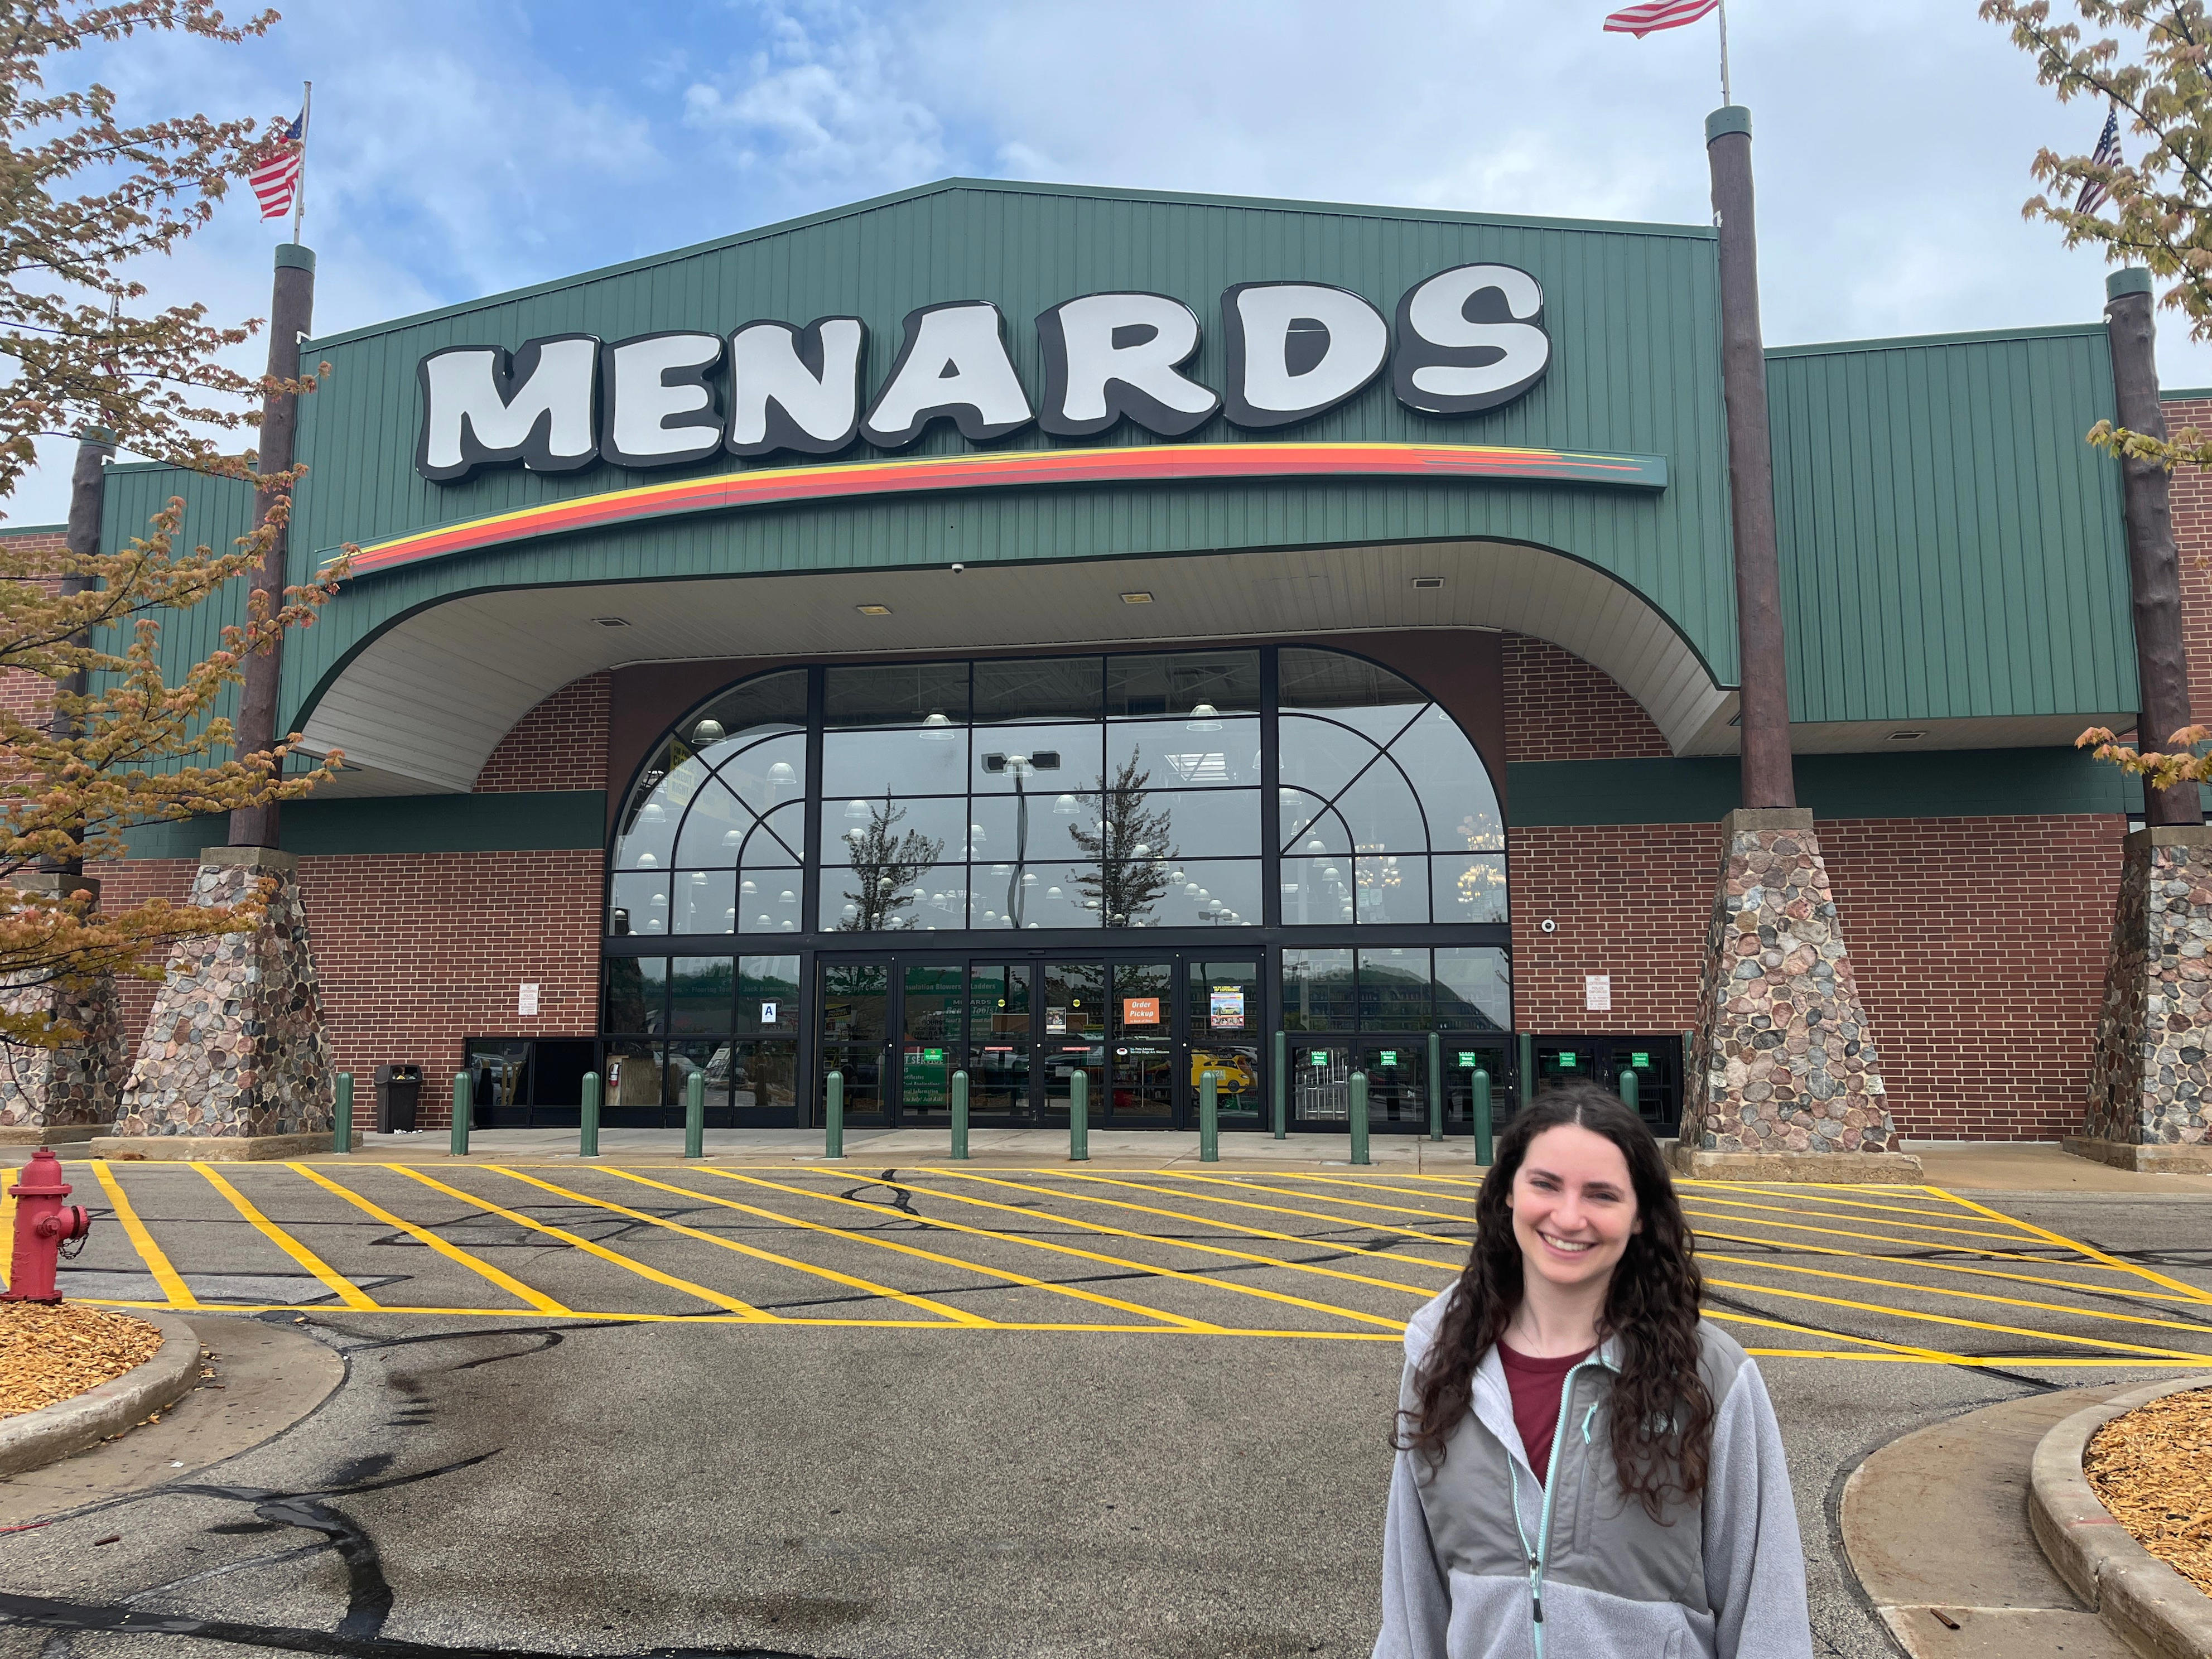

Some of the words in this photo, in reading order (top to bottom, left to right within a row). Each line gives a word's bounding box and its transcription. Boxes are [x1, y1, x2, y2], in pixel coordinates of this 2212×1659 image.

[417, 262, 1552, 483] MENARDS
[691, 986, 717, 994] Flooring
[765, 1006, 773, 1015] A
